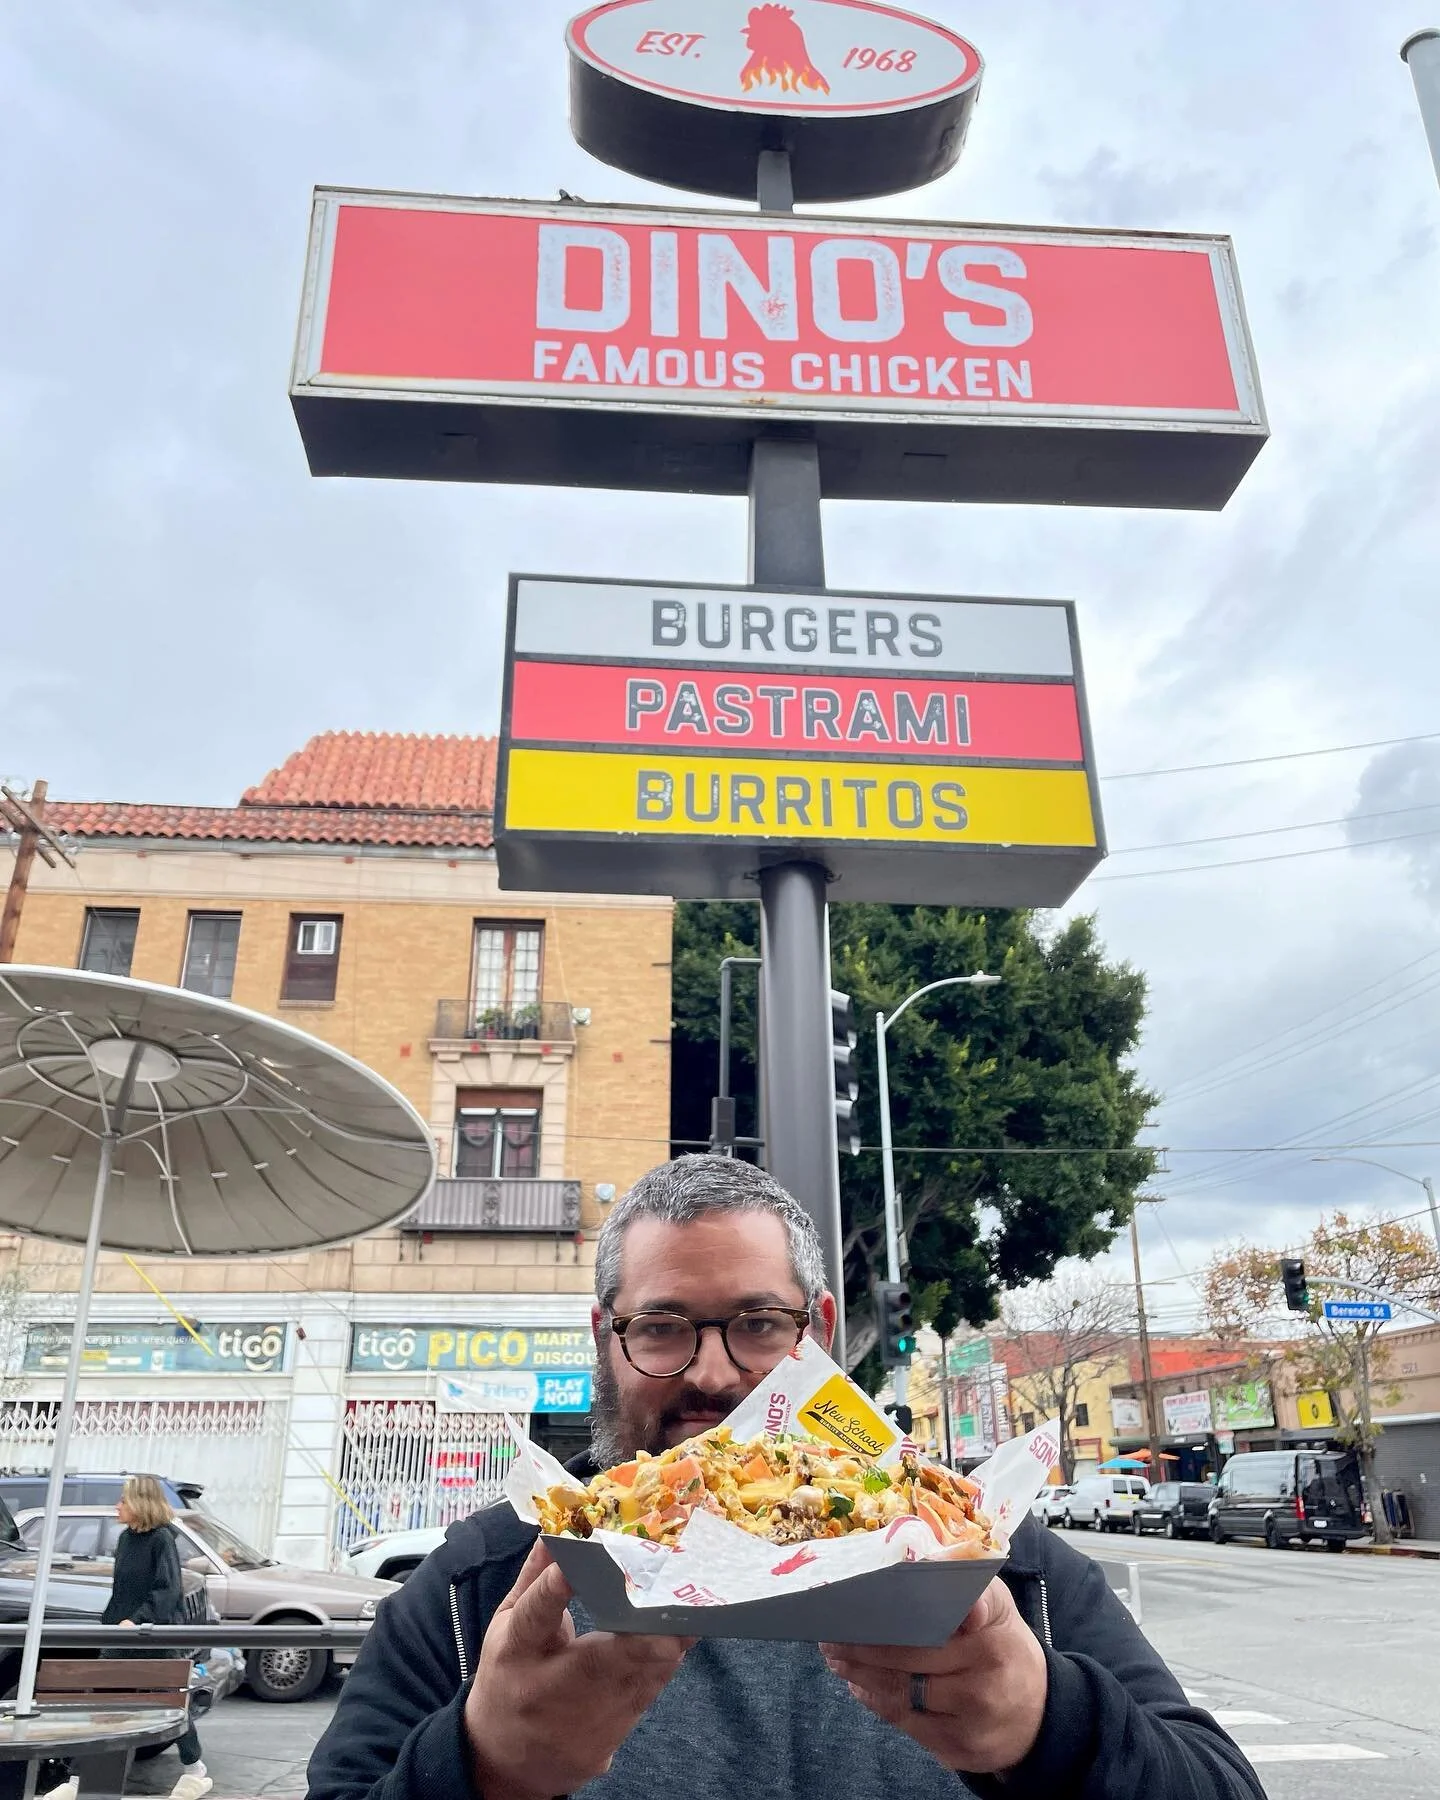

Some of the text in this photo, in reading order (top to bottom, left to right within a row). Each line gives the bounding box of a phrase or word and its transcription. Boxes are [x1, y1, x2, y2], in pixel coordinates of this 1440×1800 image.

[634, 30, 917, 73] EST. 1968
[536, 223, 1034, 347] DINO'S
[533, 340, 1033, 399] FAMOUS CHICKEN
[652, 600, 944, 658] BURGERS
[625, 678, 972, 745] PASTRAMI
[636, 769, 969, 831] BURRITOS
[428, 1328, 529, 1367] PICO
[533, 1350, 598, 1365] DISCOU
[534, 1332, 584, 1346] MART
[543, 1391, 584, 1406] NOW
[544, 1378, 585, 1391] PLAY
[764, 1392, 786, 1440] INO'S
[814, 1400, 844, 1423] New
[842, 1417, 885, 1454] School
